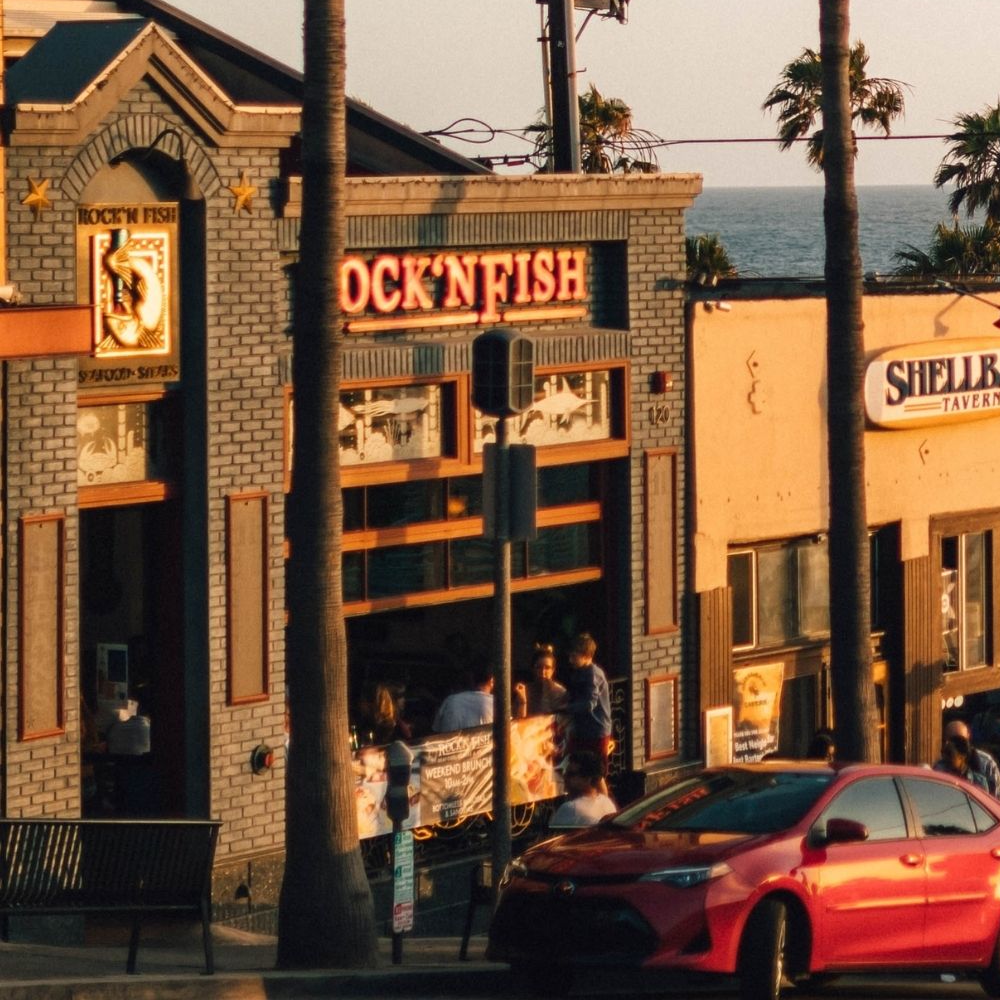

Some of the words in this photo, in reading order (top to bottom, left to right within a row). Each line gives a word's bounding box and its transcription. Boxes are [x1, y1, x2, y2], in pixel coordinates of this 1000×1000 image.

[78, 206, 138, 225] ROCK'N
[143, 205, 177, 224] FISH
[340, 254, 478, 313] OCK'N
[648, 405, 670, 425] 120
[425, 765, 460, 779] WEEKEND
[462, 758, 490, 773] BRUNCH
